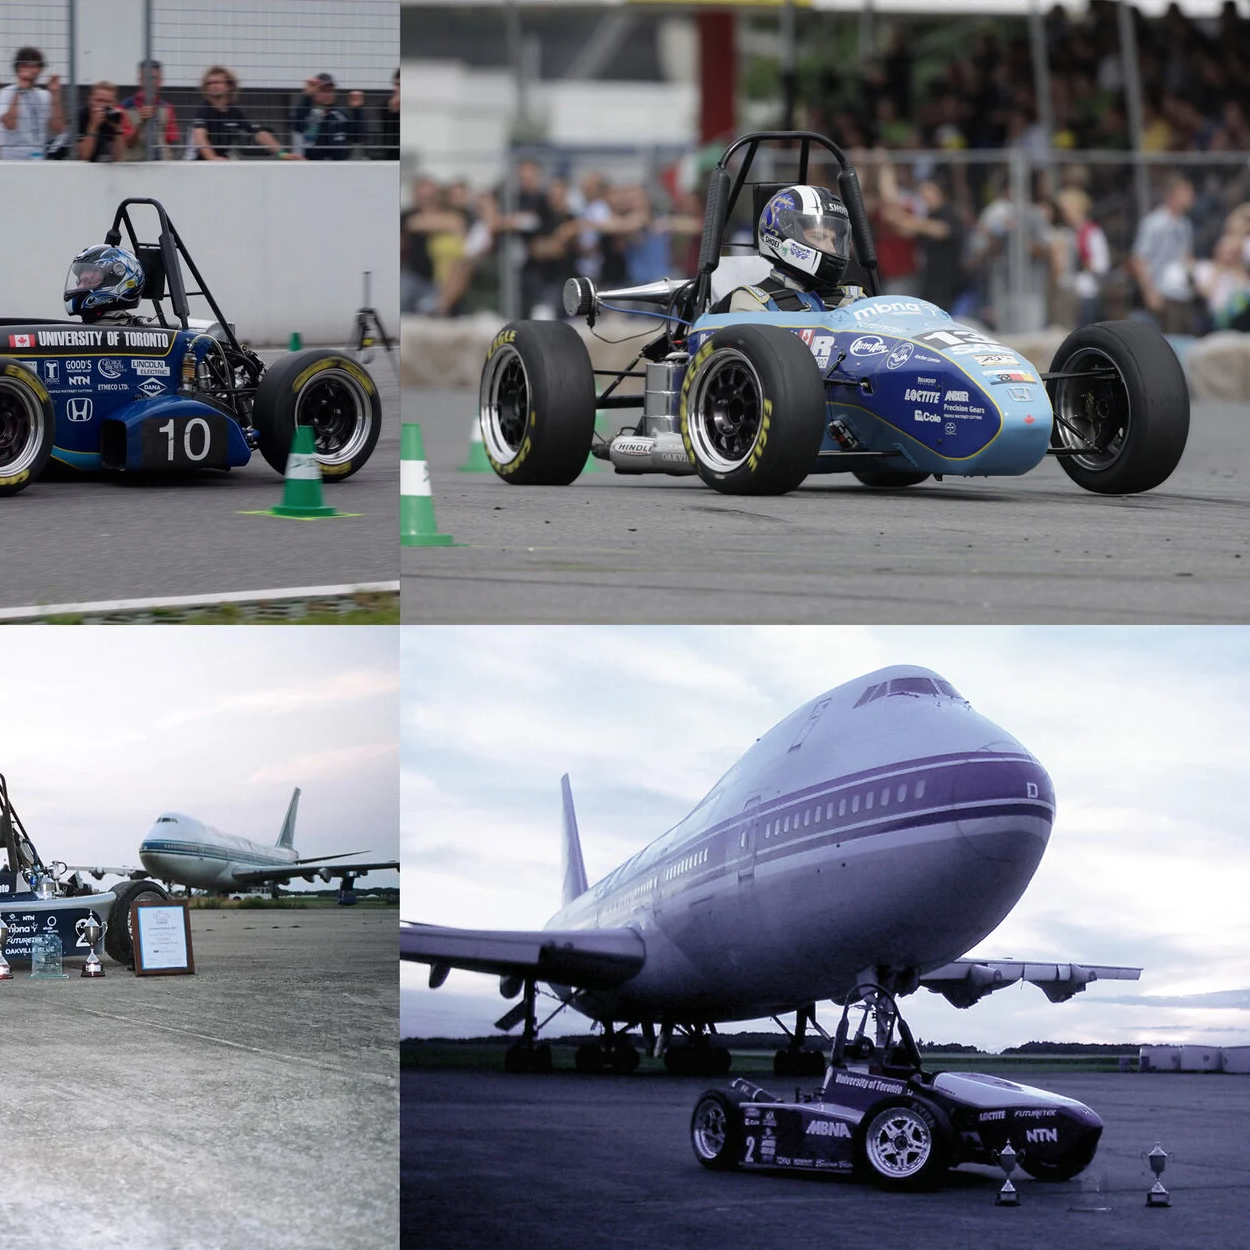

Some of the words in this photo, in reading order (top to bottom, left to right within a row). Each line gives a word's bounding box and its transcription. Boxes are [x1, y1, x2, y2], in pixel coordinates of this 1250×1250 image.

[765, 235, 780, 248] SHOEI
[853, 302, 922, 321] mbna
[38, 331, 102, 347] UNIVERSITY
[106, 331, 119, 347] OF
[125, 331, 169, 348] TORONTO
[65, 359, 92, 370] GOOD'S
[132, 360, 164, 368] LINCOLN
[68, 375, 91, 386] NTN
[97, 383, 117, 391] ETMECO
[904, 389, 941, 404] LOCTITE
[943, 404, 968, 413] Precision
[969, 405, 985, 415] Gears
[923, 412, 941, 423] Cole
[159, 418, 211, 461] 10
[746, 397, 773, 474] EAGLE
[1026, 782, 1039, 799] D
[835, 1073, 868, 1089] University
[868, 1079, 875, 1090] of
[876, 1080, 903, 1094] Toronto
[979, 1110, 1006, 1122] LOCTITE
[1013, 1108, 1057, 1118] FUTURETEK
[806, 1120, 852, 1138] MBNA
[1026, 1128, 1058, 1143] NTN
[745, 1136, 755, 1163] 2
